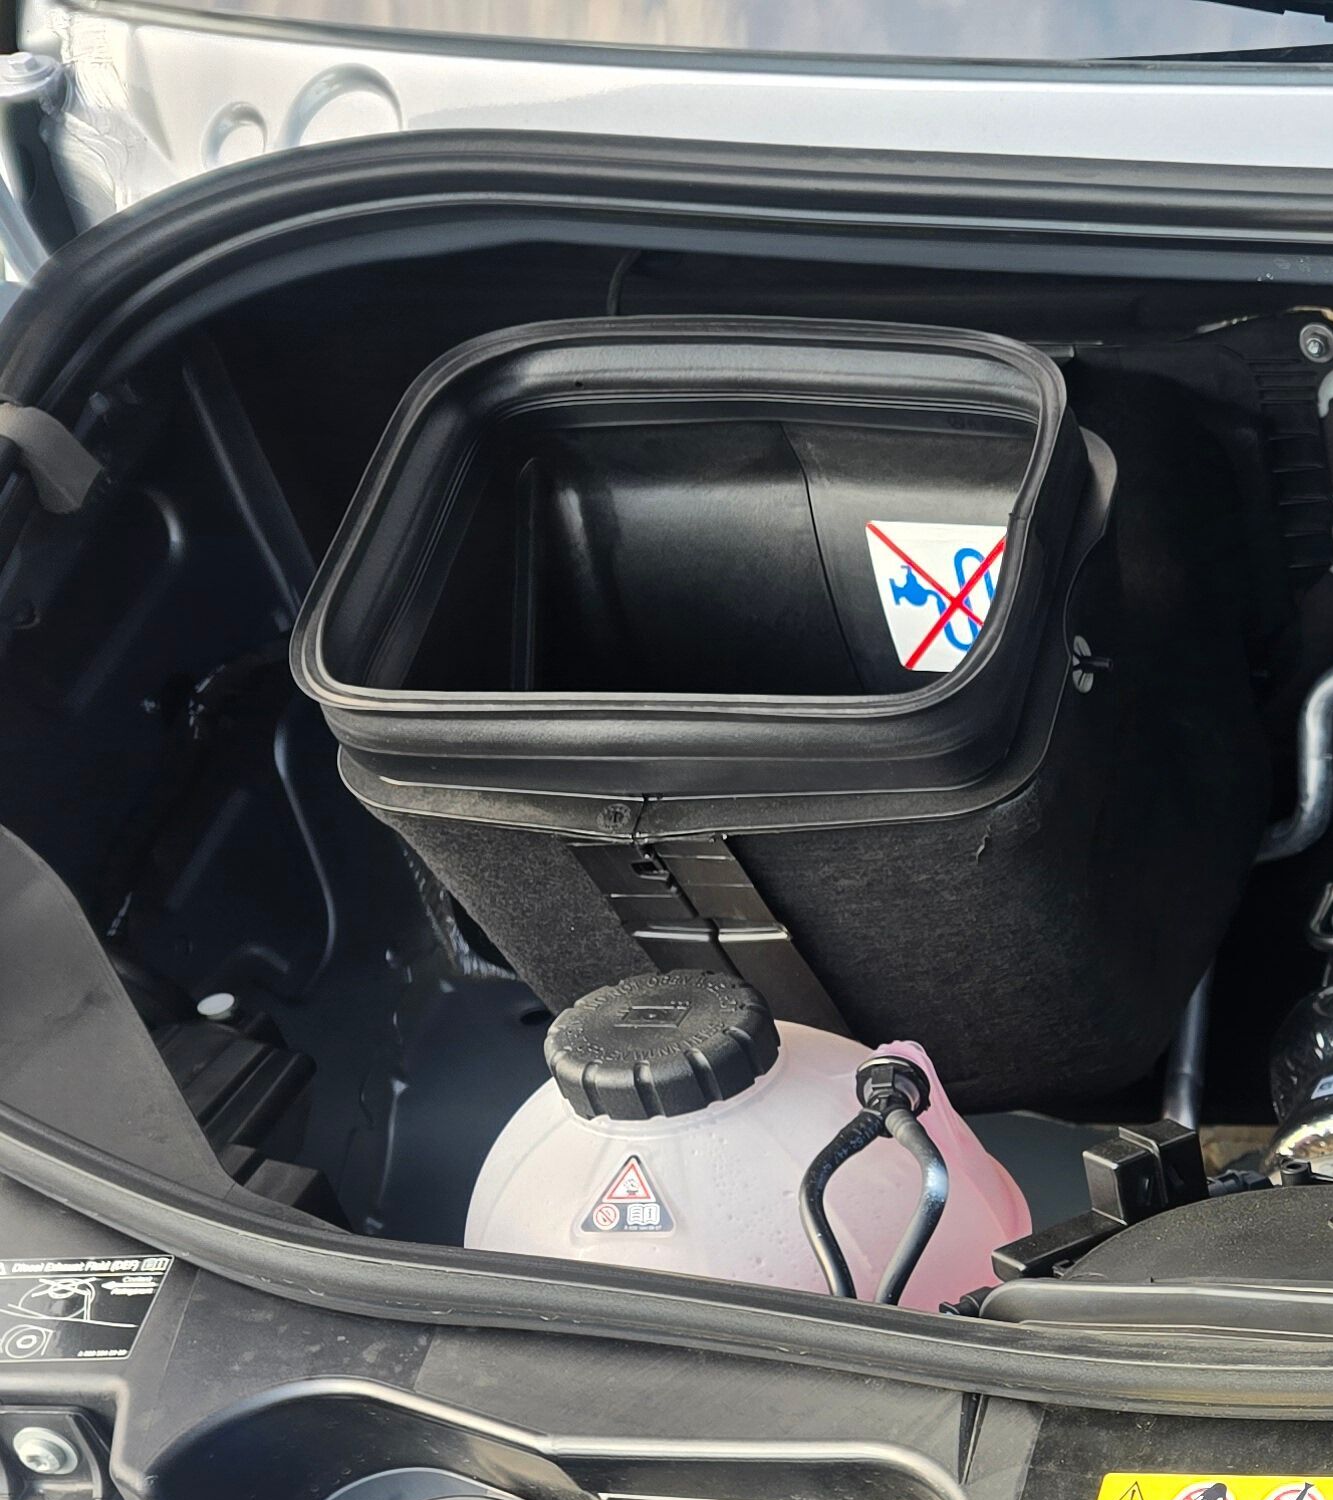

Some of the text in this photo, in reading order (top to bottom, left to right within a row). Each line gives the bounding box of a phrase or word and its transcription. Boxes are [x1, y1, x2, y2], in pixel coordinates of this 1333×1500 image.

[12, 1259, 140, 1273] Diesel Exhaust Fluid (DEF)
